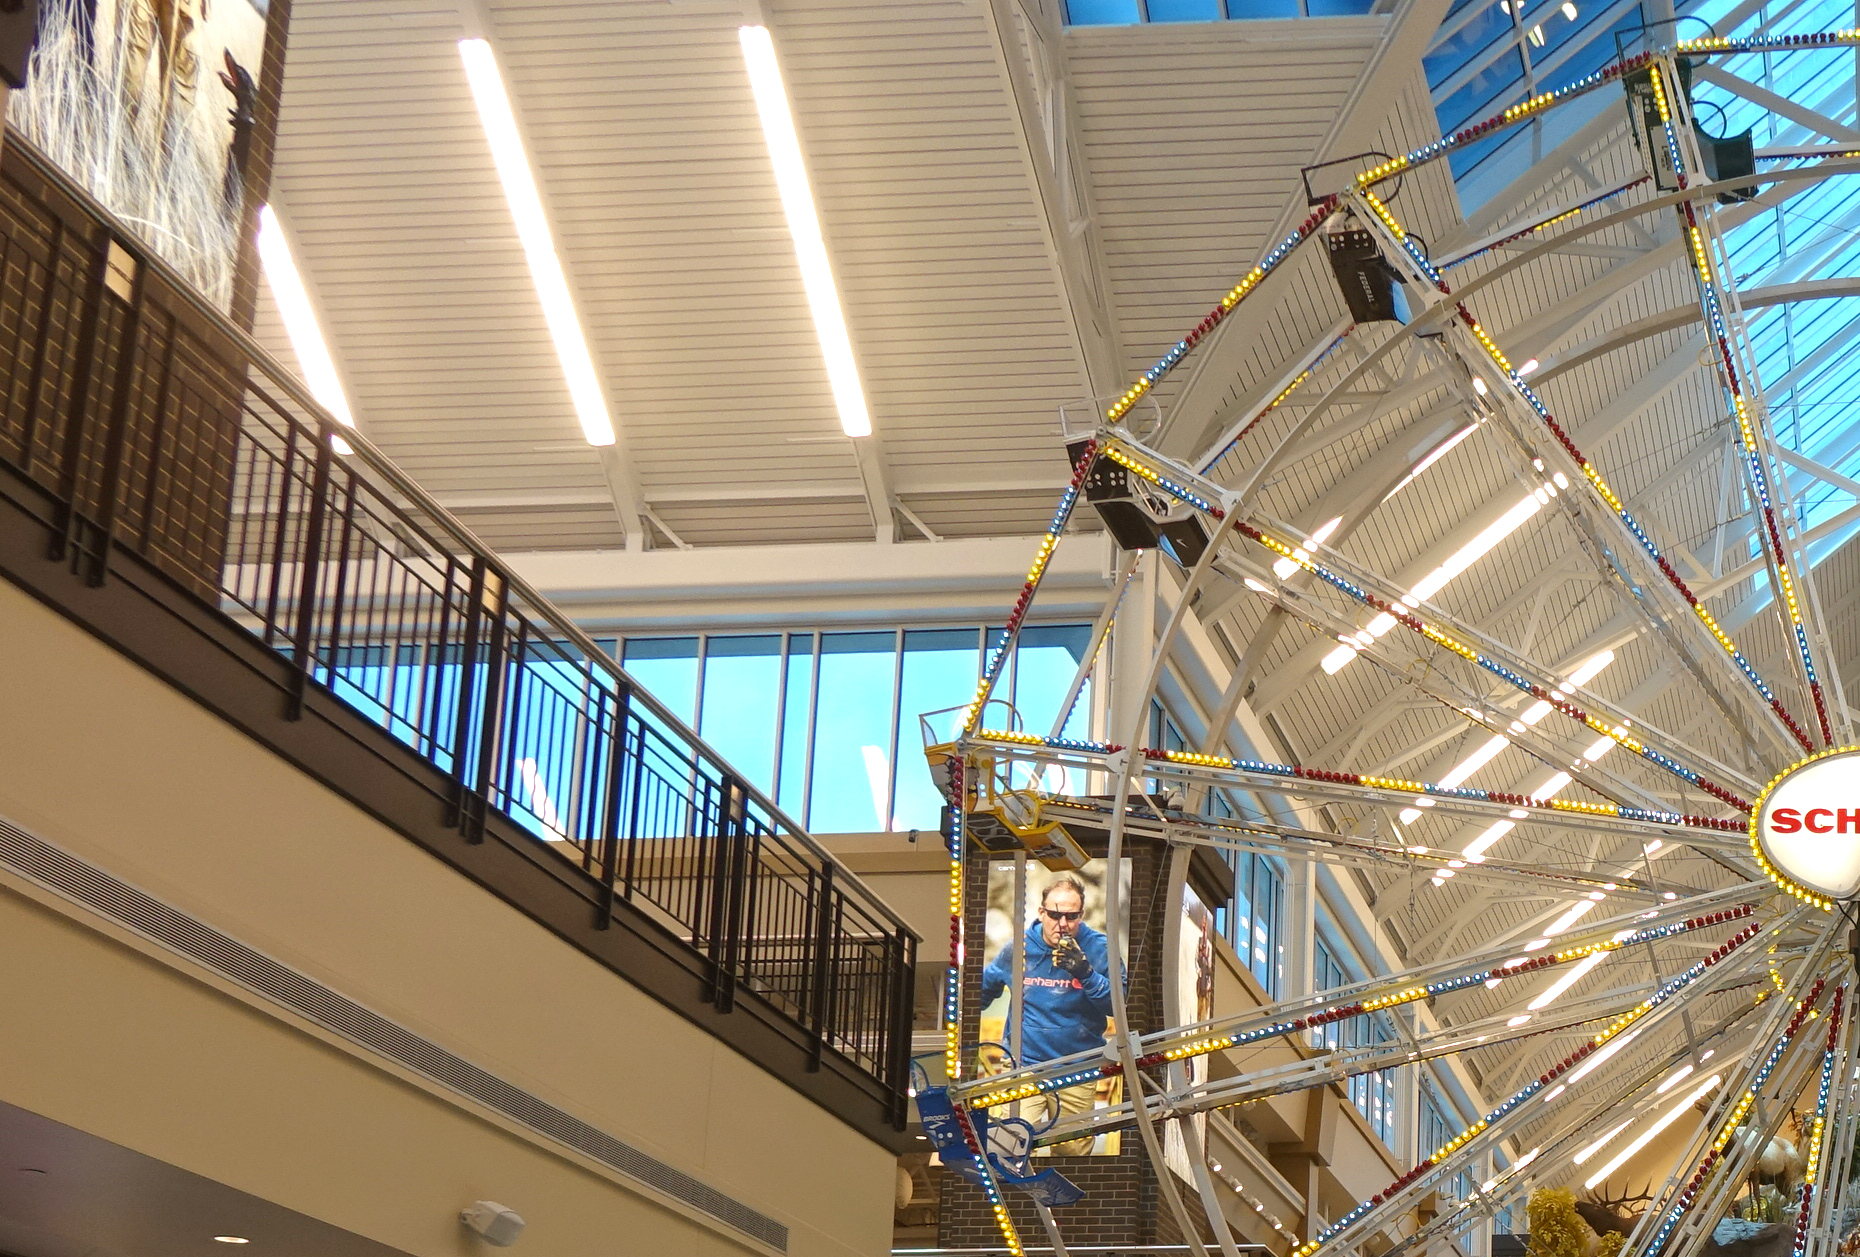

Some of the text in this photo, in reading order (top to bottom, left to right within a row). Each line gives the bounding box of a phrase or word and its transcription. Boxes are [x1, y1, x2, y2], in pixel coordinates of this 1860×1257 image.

[1357, 271, 1375, 303] FEDERAL
[1023, 976, 1071, 988] arhartt
[923, 1114, 950, 1122] BROOKS
